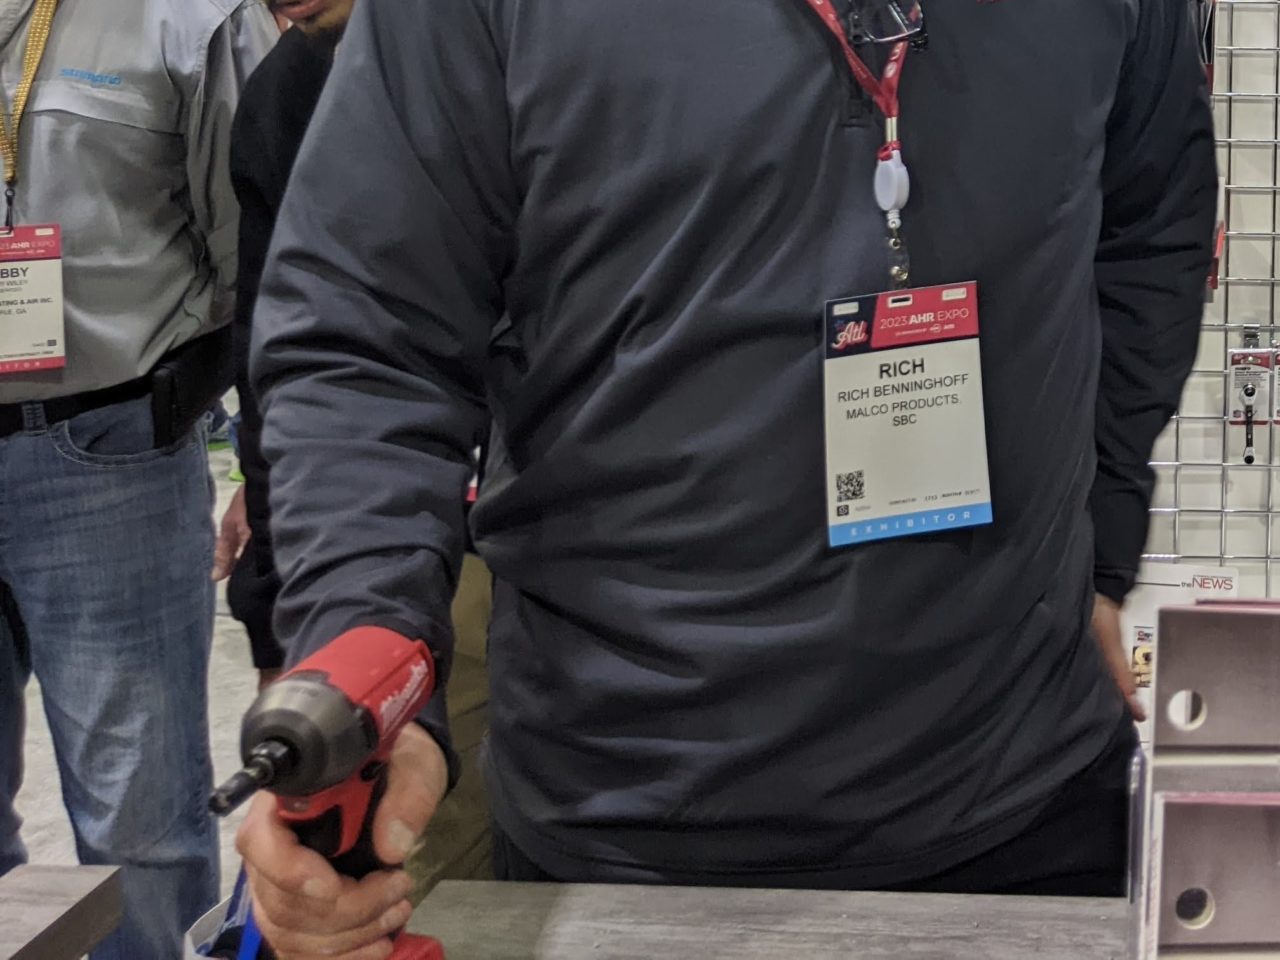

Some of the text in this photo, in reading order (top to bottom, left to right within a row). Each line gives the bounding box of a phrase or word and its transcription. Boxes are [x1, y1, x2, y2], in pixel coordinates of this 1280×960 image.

[880, 307, 969, 329] 2023 AHR EXPO
[879, 358, 925, 379] RICH
[838, 373, 969, 403] RICH BENNINGHOFF
[846, 403, 888, 419] MALCO
[892, 413, 917, 427] SBC
[851, 511, 971, 536] EXHIBITOR
[1192, 577, 1233, 590] NEWS
